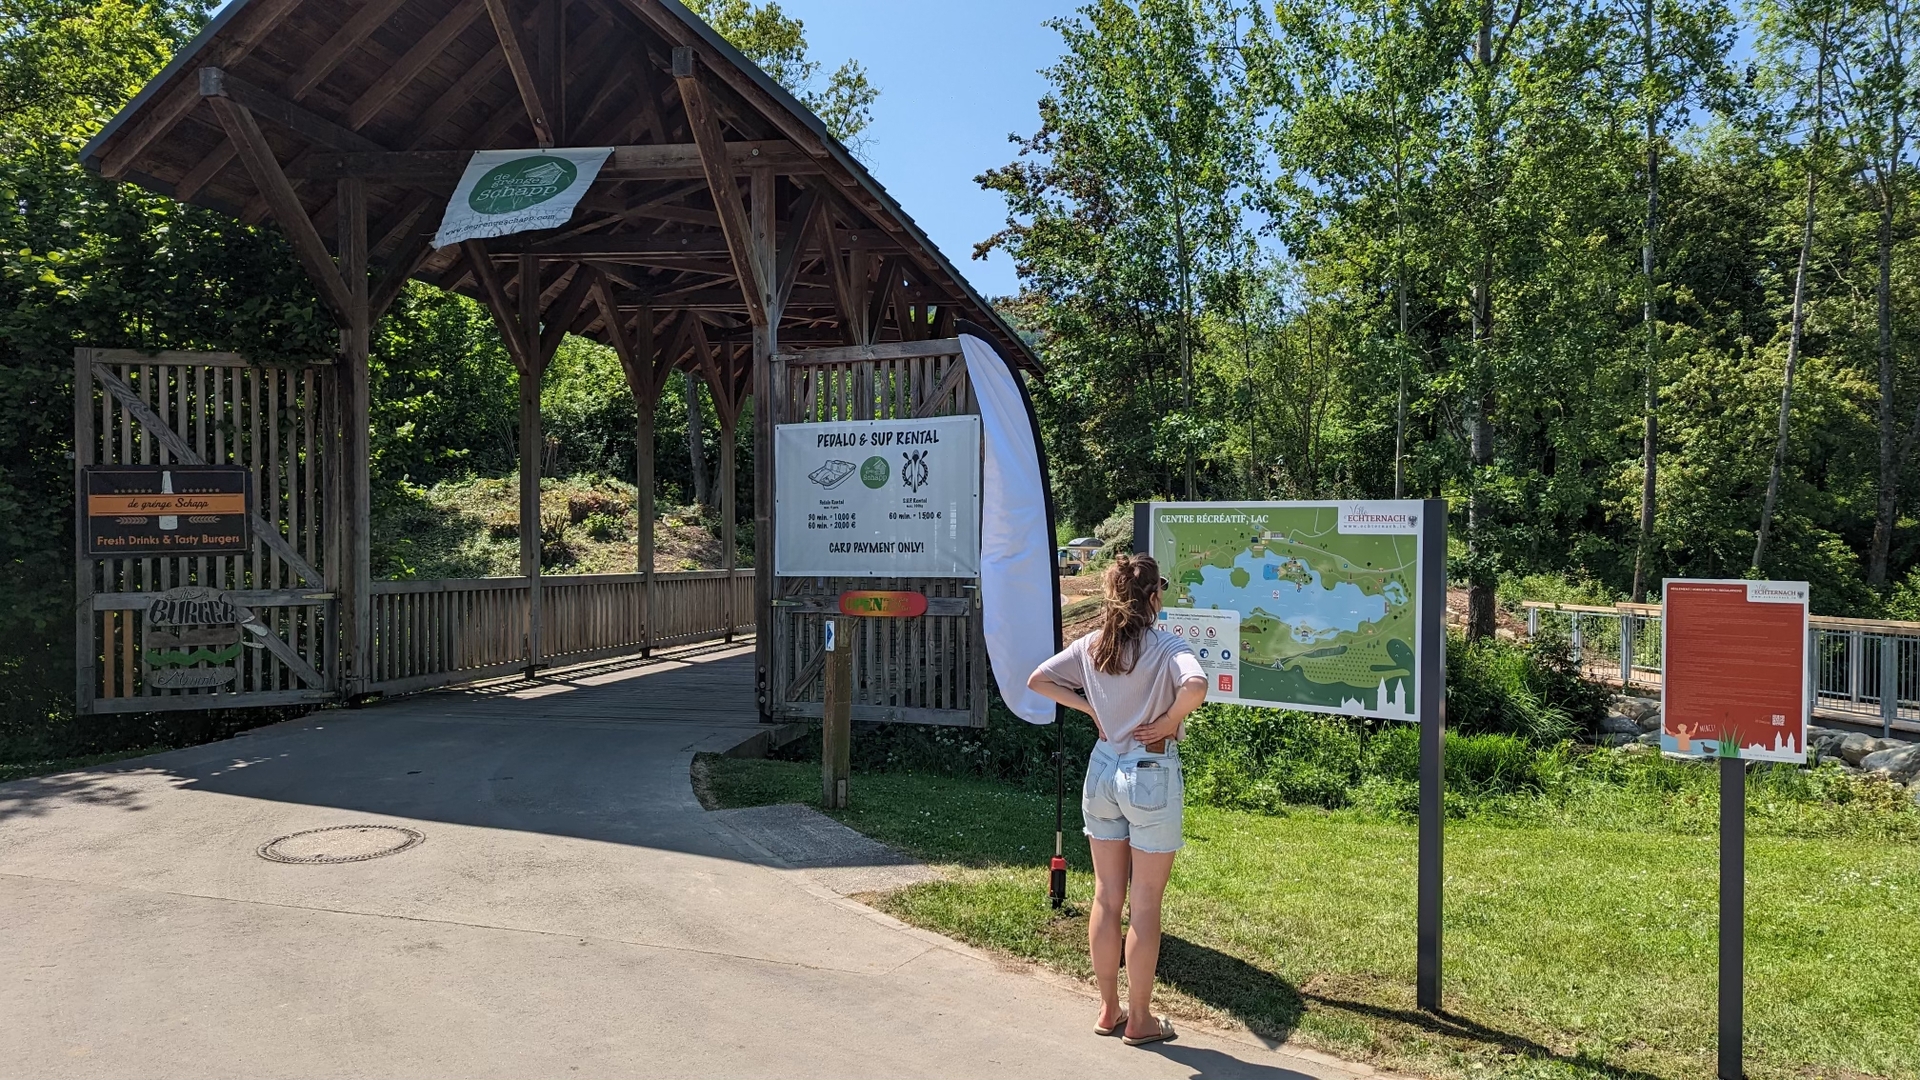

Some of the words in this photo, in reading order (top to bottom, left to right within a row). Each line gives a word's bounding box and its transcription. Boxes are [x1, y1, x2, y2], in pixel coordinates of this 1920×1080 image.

[494, 173, 511, 181] de
[817, 432, 857, 448] PEDALO
[859, 434, 868, 446] &
[870, 432, 893, 446] SUP
[896, 429, 940, 445] RENTAL
[127, 498, 139, 508] de
[175, 497, 209, 512] Schapp
[817, 513, 829, 521] min.
[834, 512, 850, 521] 10,00
[851, 512, 857, 520] €
[888, 511, 897, 520] 60
[898, 511, 911, 520] min.
[918, 511, 935, 520] 15,00
[936, 511, 942, 519] €
[1160, 514, 1195, 524] CENTRE
[1196, 512, 1249, 525] RÉCRÉATIF,
[1250, 514, 1269, 524] LAC
[808, 521, 816, 530] 60
[834, 521, 850, 530] 20,00
[851, 521, 857, 529] €
[97, 536, 125, 546] Fresh
[129, 535, 160, 545] Drinks
[162, 535, 171, 545] &
[174, 534, 199, 545] Tasty
[202, 534, 240, 545] Burgers
[829, 542, 852, 554] CARD
[853, 541, 895, 554] PAYMENT
[897, 541, 925, 553] ONLY!
[149, 593, 236, 624] BURGER
[1220, 683, 1232, 691] 112
